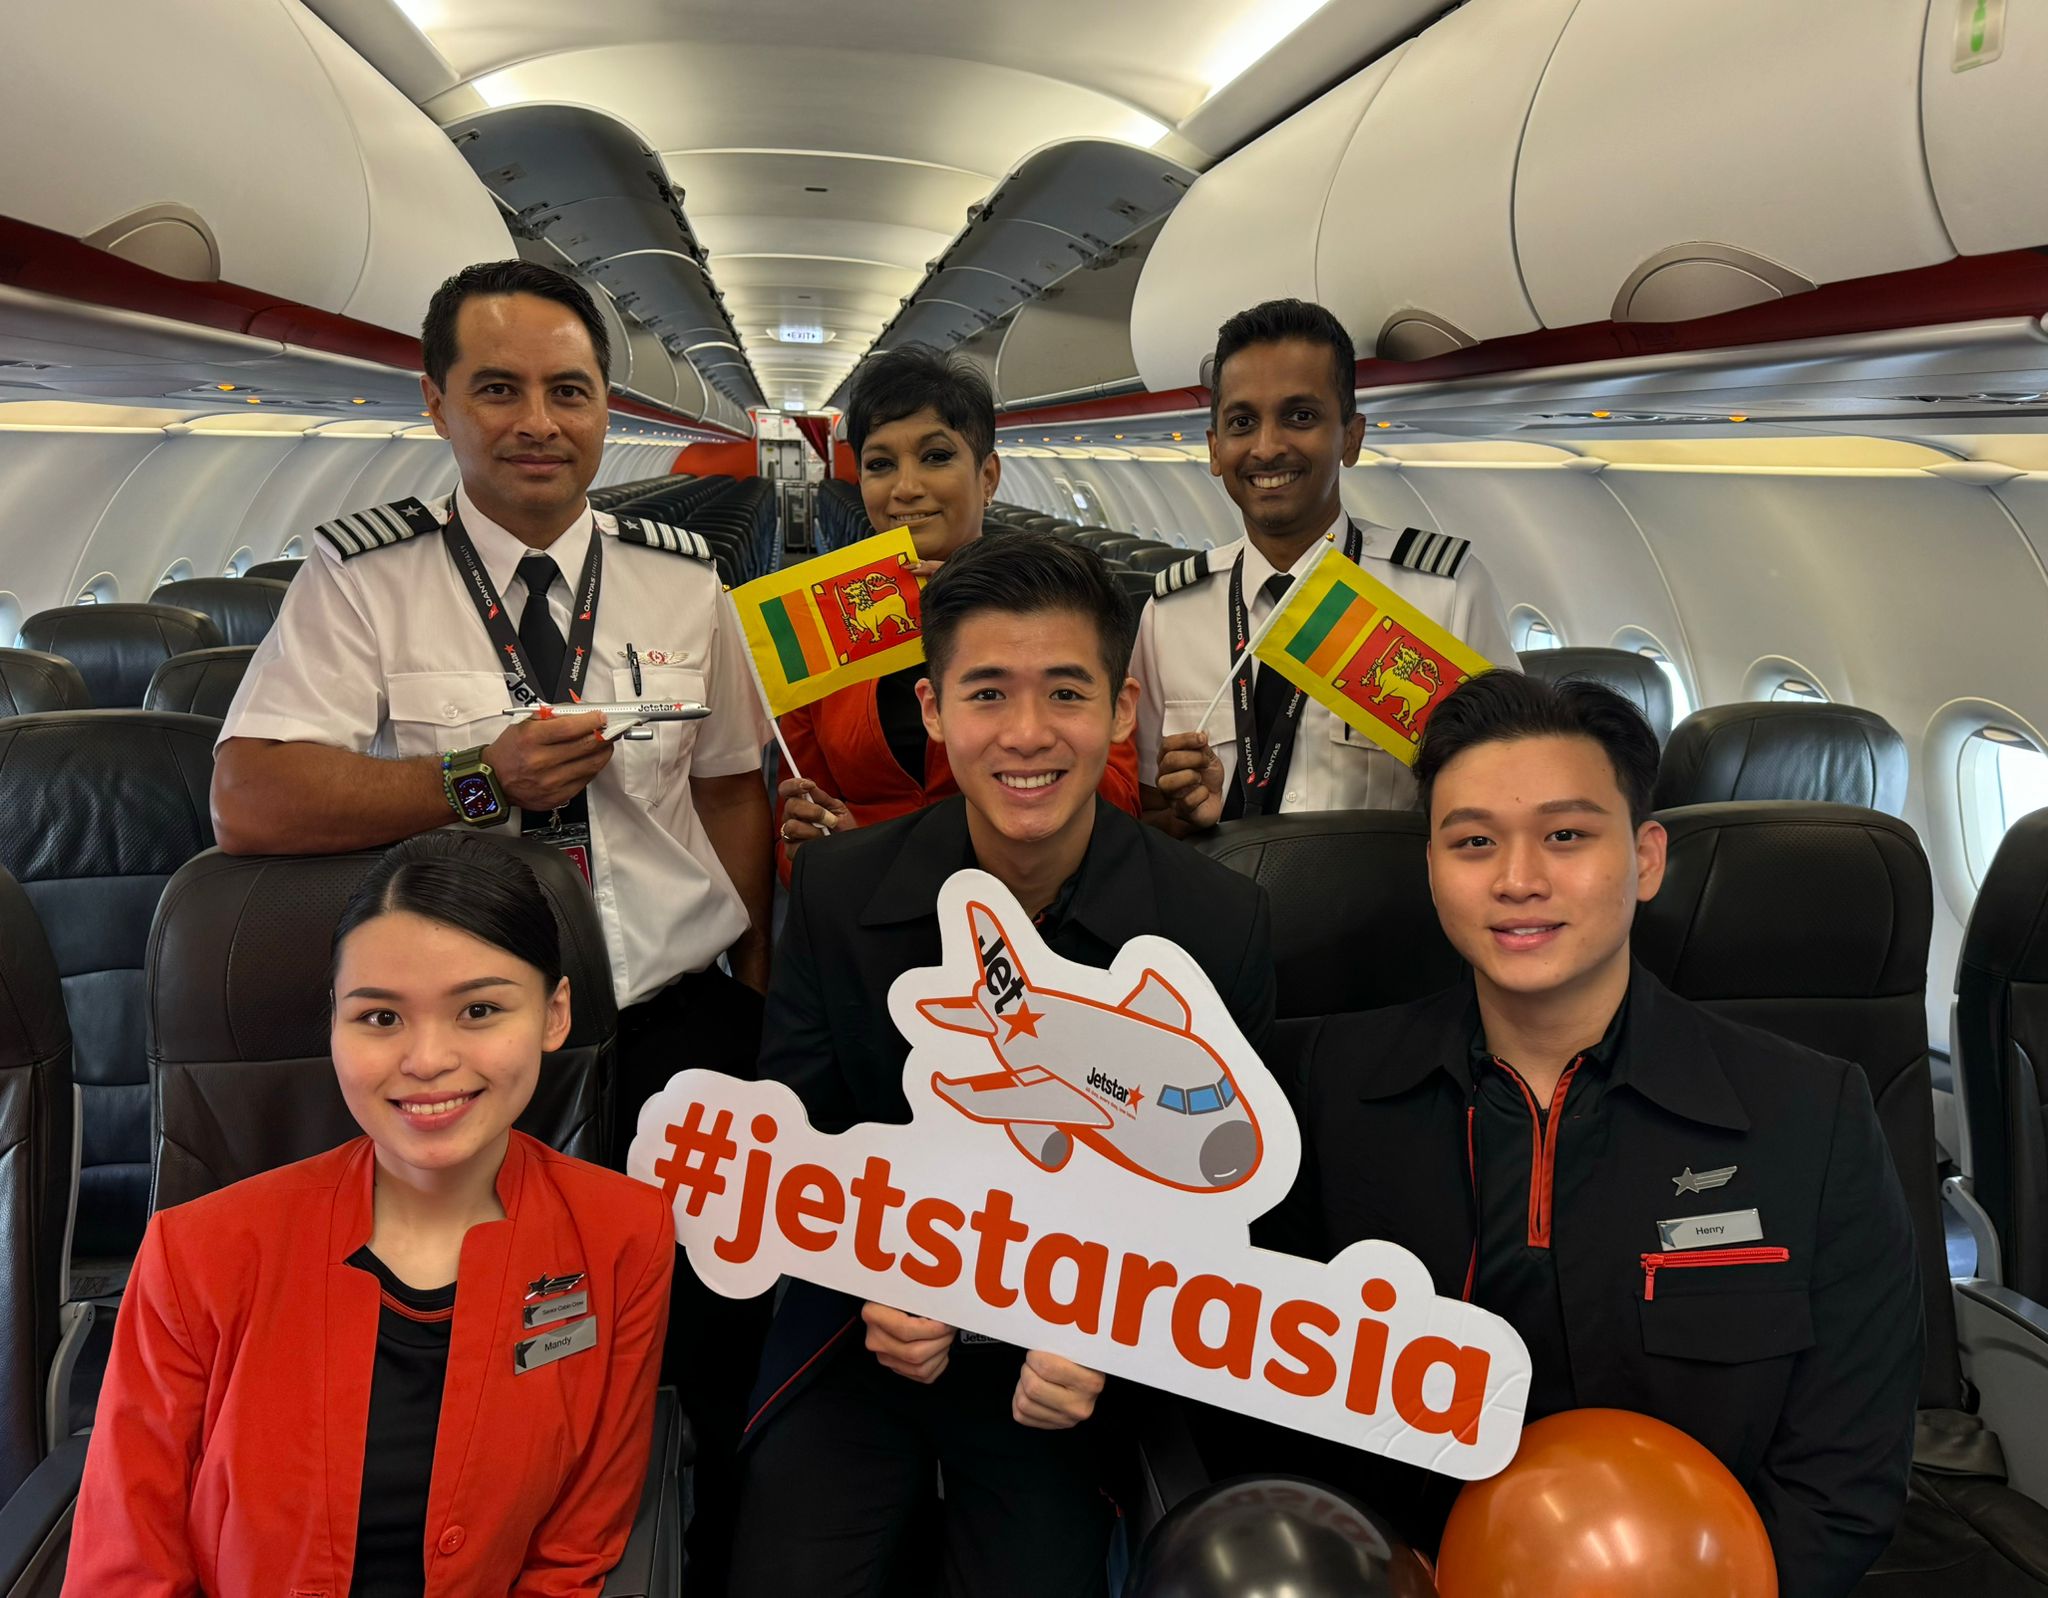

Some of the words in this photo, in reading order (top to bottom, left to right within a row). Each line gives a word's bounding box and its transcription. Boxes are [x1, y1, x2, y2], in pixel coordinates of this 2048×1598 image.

[791, 331, 811, 340] EXIT
[472, 569, 493, 607] QANTAS
[583, 577, 596, 612] QANTAS
[1235, 605, 1243, 641] QANTAS
[509, 651, 527, 679] Jetstar
[569, 654, 582, 682] Jetstar
[506, 679, 538, 707] Jet
[638, 703, 674, 713] Jetstar
[1245, 736, 1254, 774] QANTAS
[1263, 743, 1282, 779] QANTAS
[978, 934, 1025, 1015] Jet
[1086, 1066, 1130, 1104] Jetstar
[1695, 1225, 1725, 1235] Henry
[654, 1102, 1491, 1446] #jetstarasia
[544, 1336, 572, 1352] Mandy
